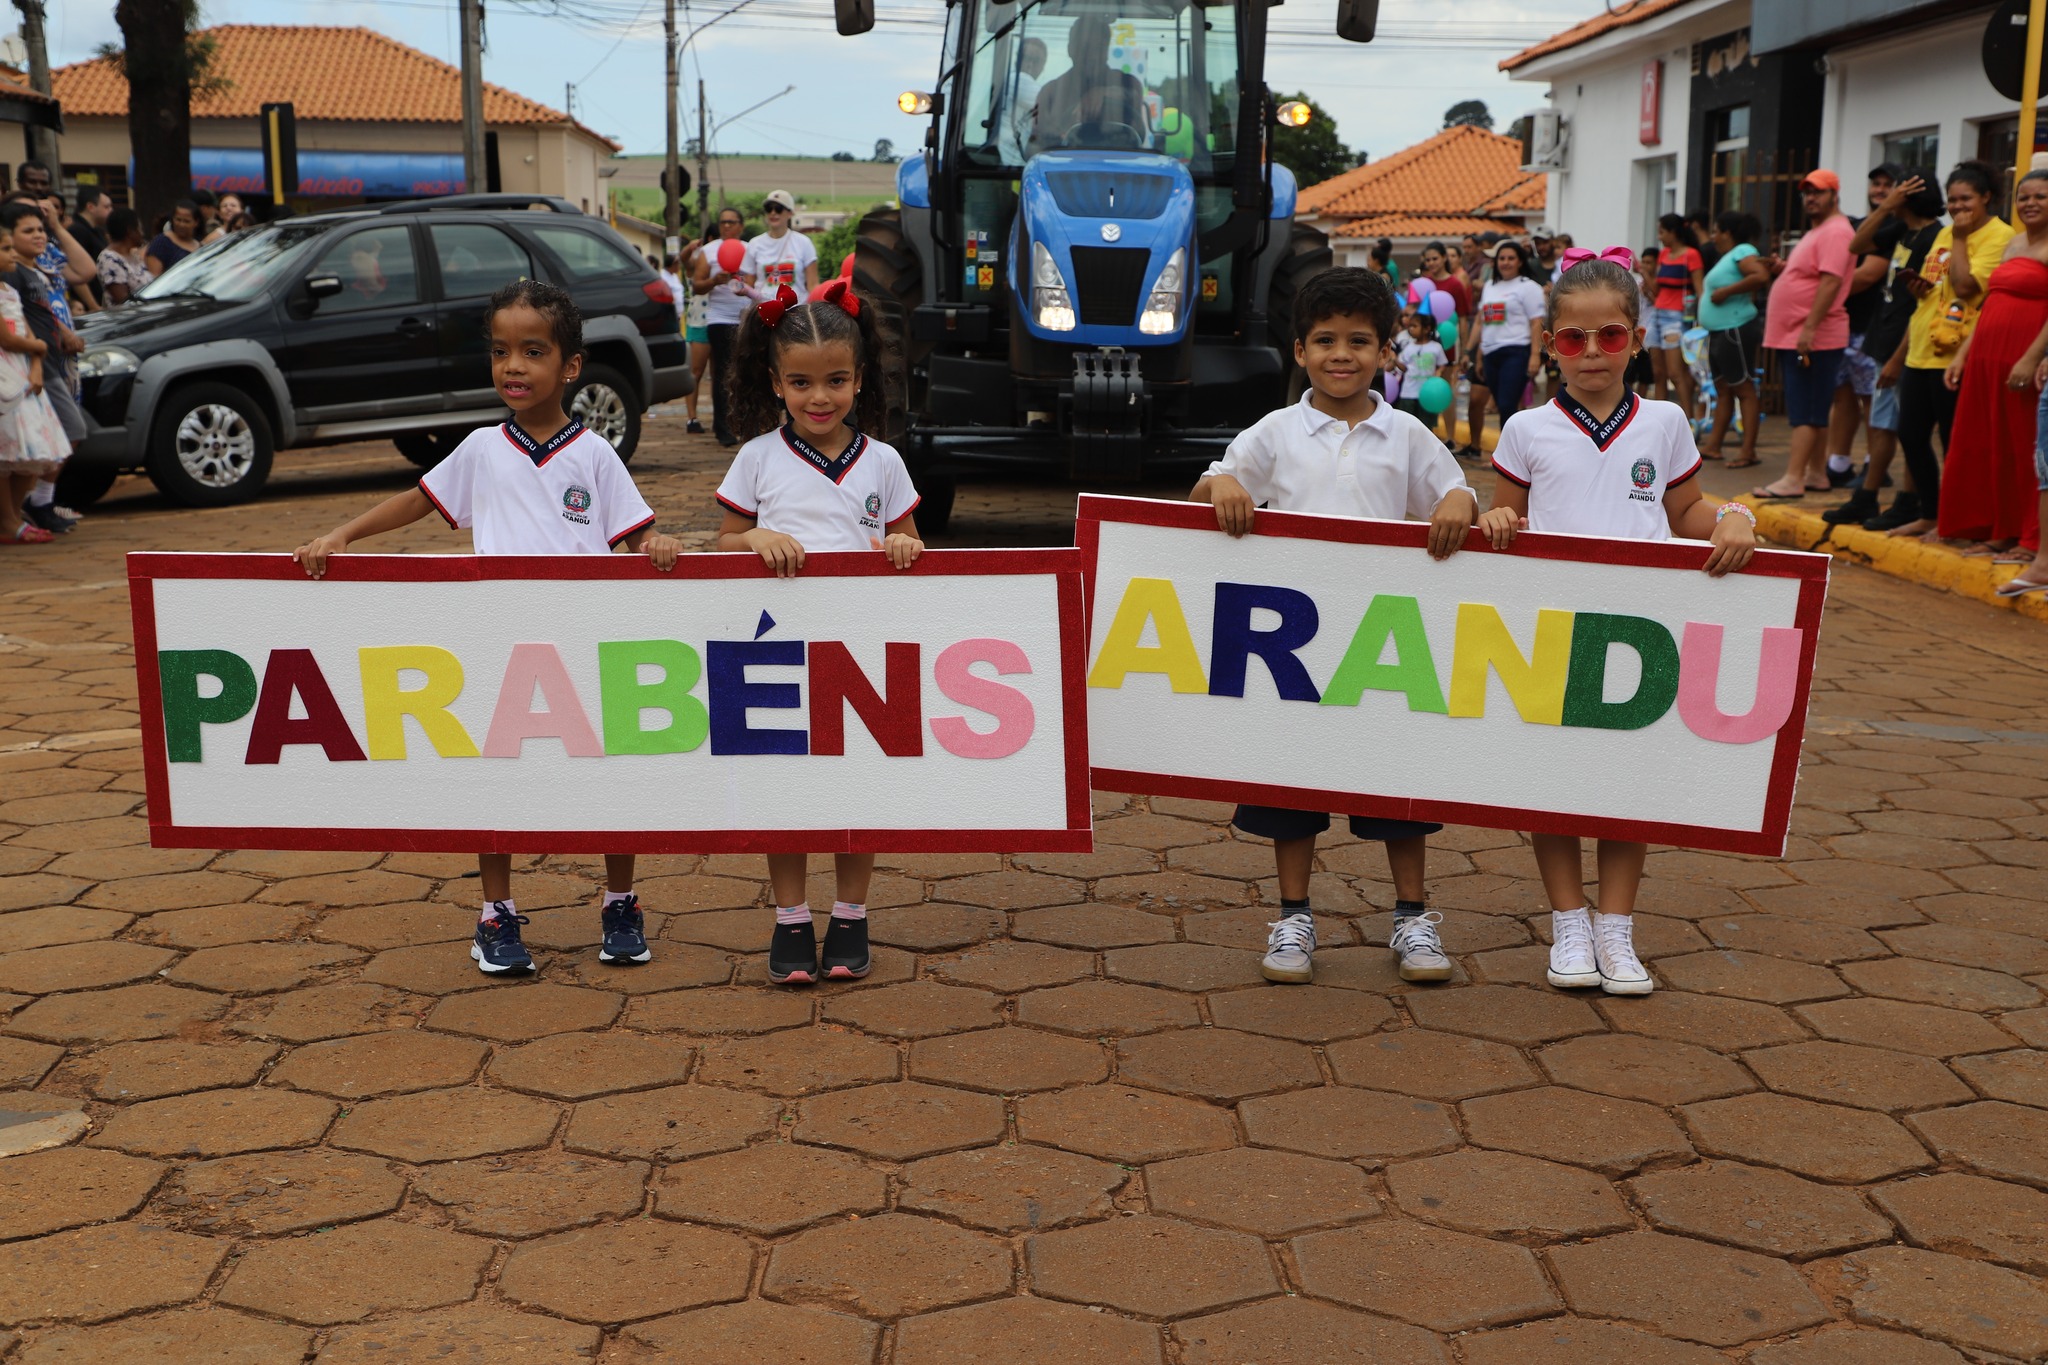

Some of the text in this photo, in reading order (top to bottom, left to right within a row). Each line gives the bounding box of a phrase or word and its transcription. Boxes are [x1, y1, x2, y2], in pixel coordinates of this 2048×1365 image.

[1600, 401, 1629, 439] ARANDU
[508, 424, 537, 452] ARANDU
[547, 421, 580, 450] ARANDU
[794, 439, 828, 468] ARANDU
[1628, 493, 1656, 502] ARANDU
[1087, 576, 1804, 745] ARANDU
[157, 609, 1036, 766] PARABÉNS
